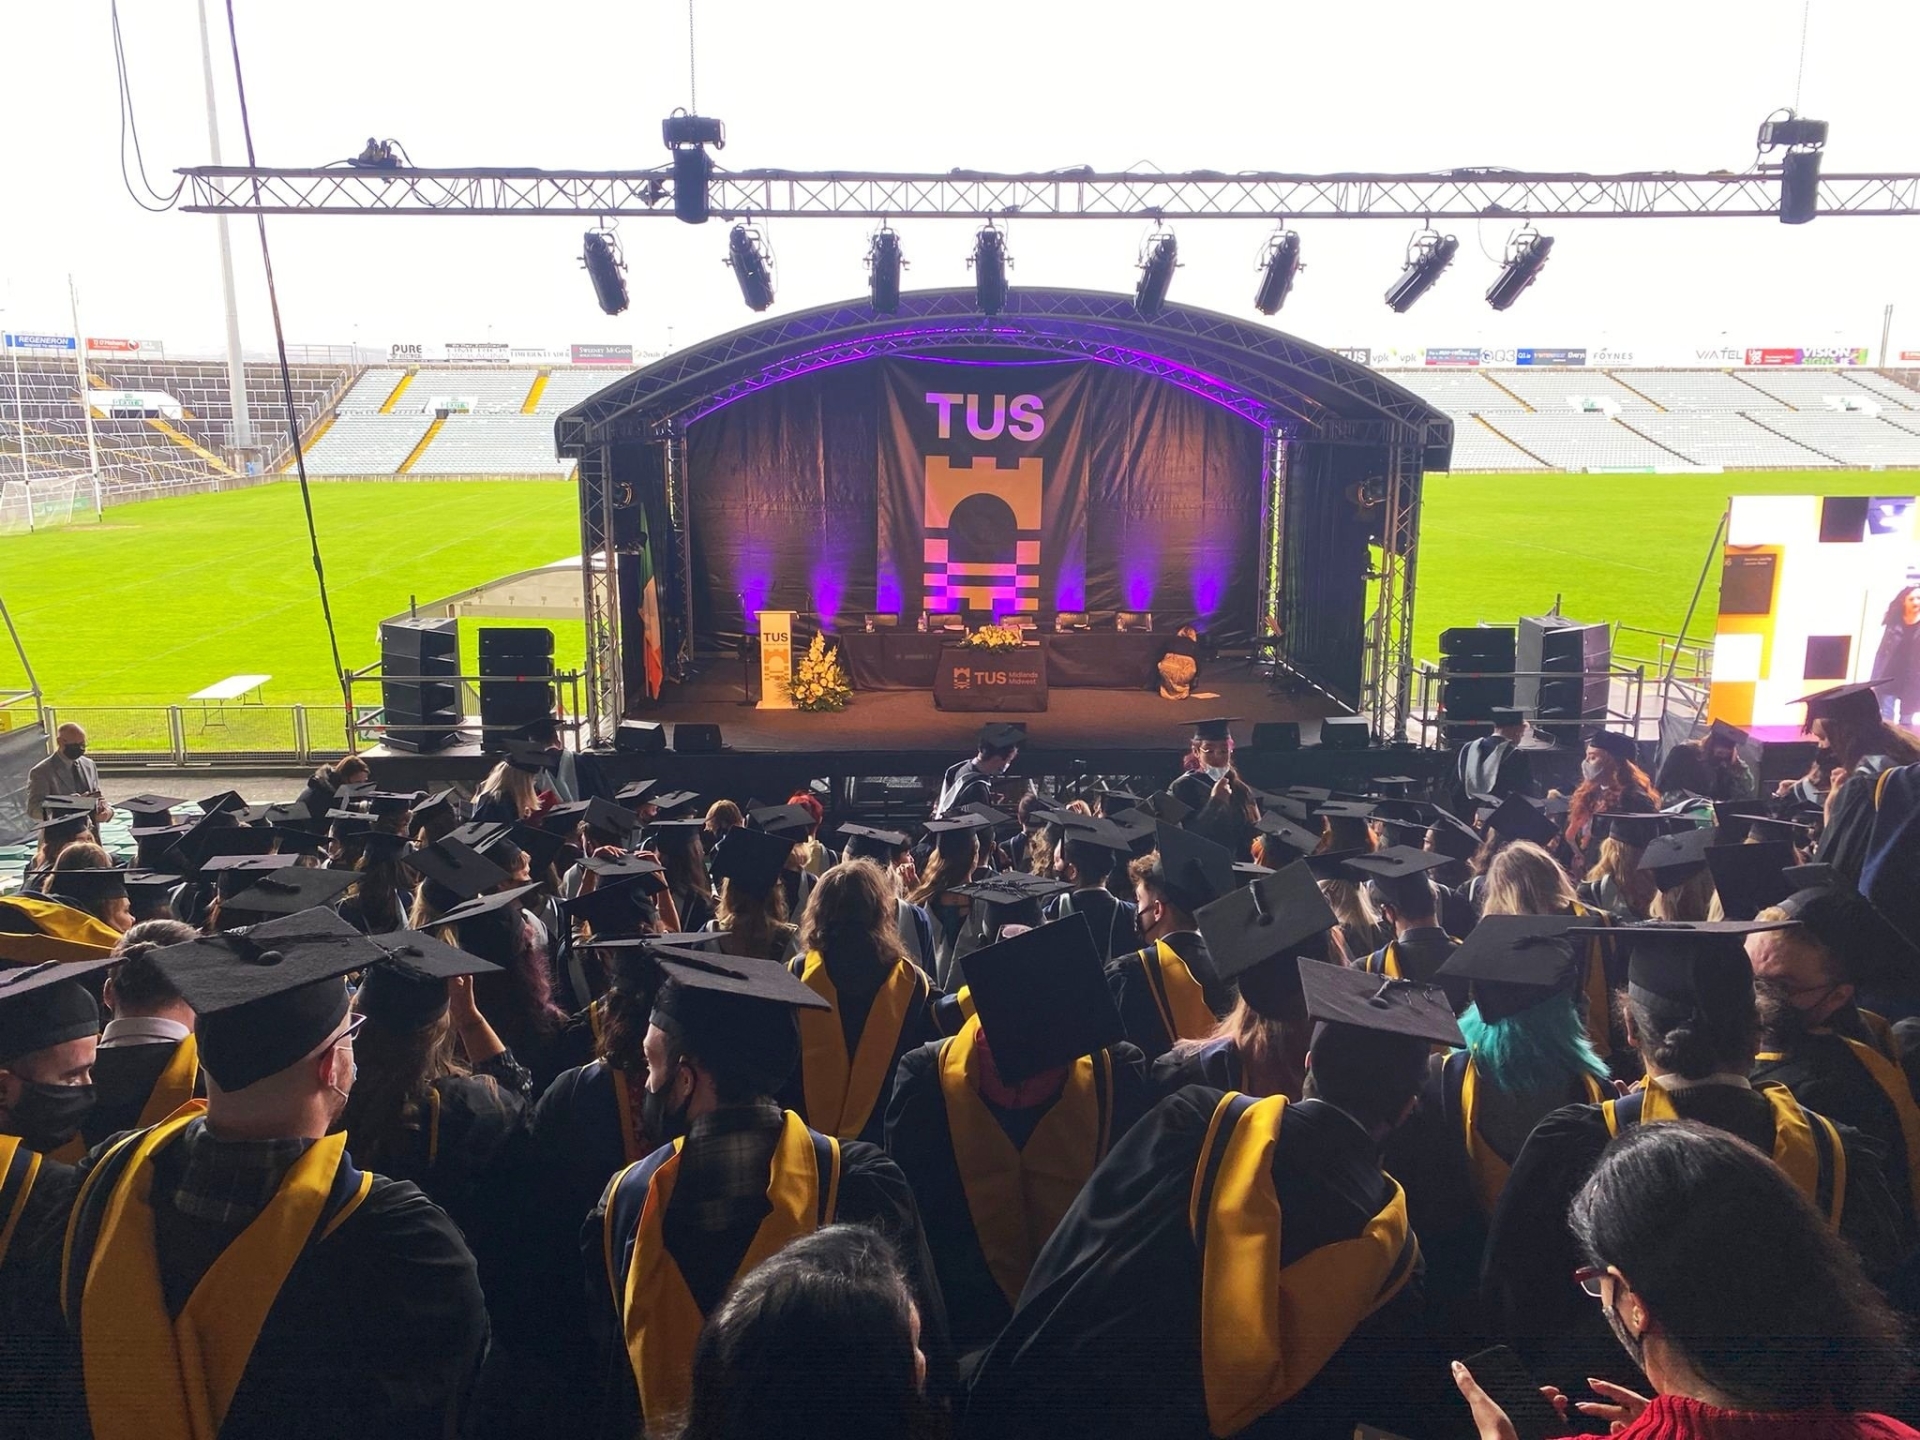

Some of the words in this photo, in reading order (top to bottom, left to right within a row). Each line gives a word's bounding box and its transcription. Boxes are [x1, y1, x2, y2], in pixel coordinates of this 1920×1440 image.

[18, 337, 69, 345] REGENERON
[392, 344, 422, 357] PURE
[1695, 350, 1743, 360] VIATEL
[1803, 347, 1850, 357] VISION
[1372, 353, 1389, 364] vpk
[1400, 353, 1417, 364] vpk
[1593, 352, 1634, 360] FOYNES
[925, 392, 1045, 442] TUS
[763, 632, 789, 642] TUS
[974, 671, 1007, 685] TUS
